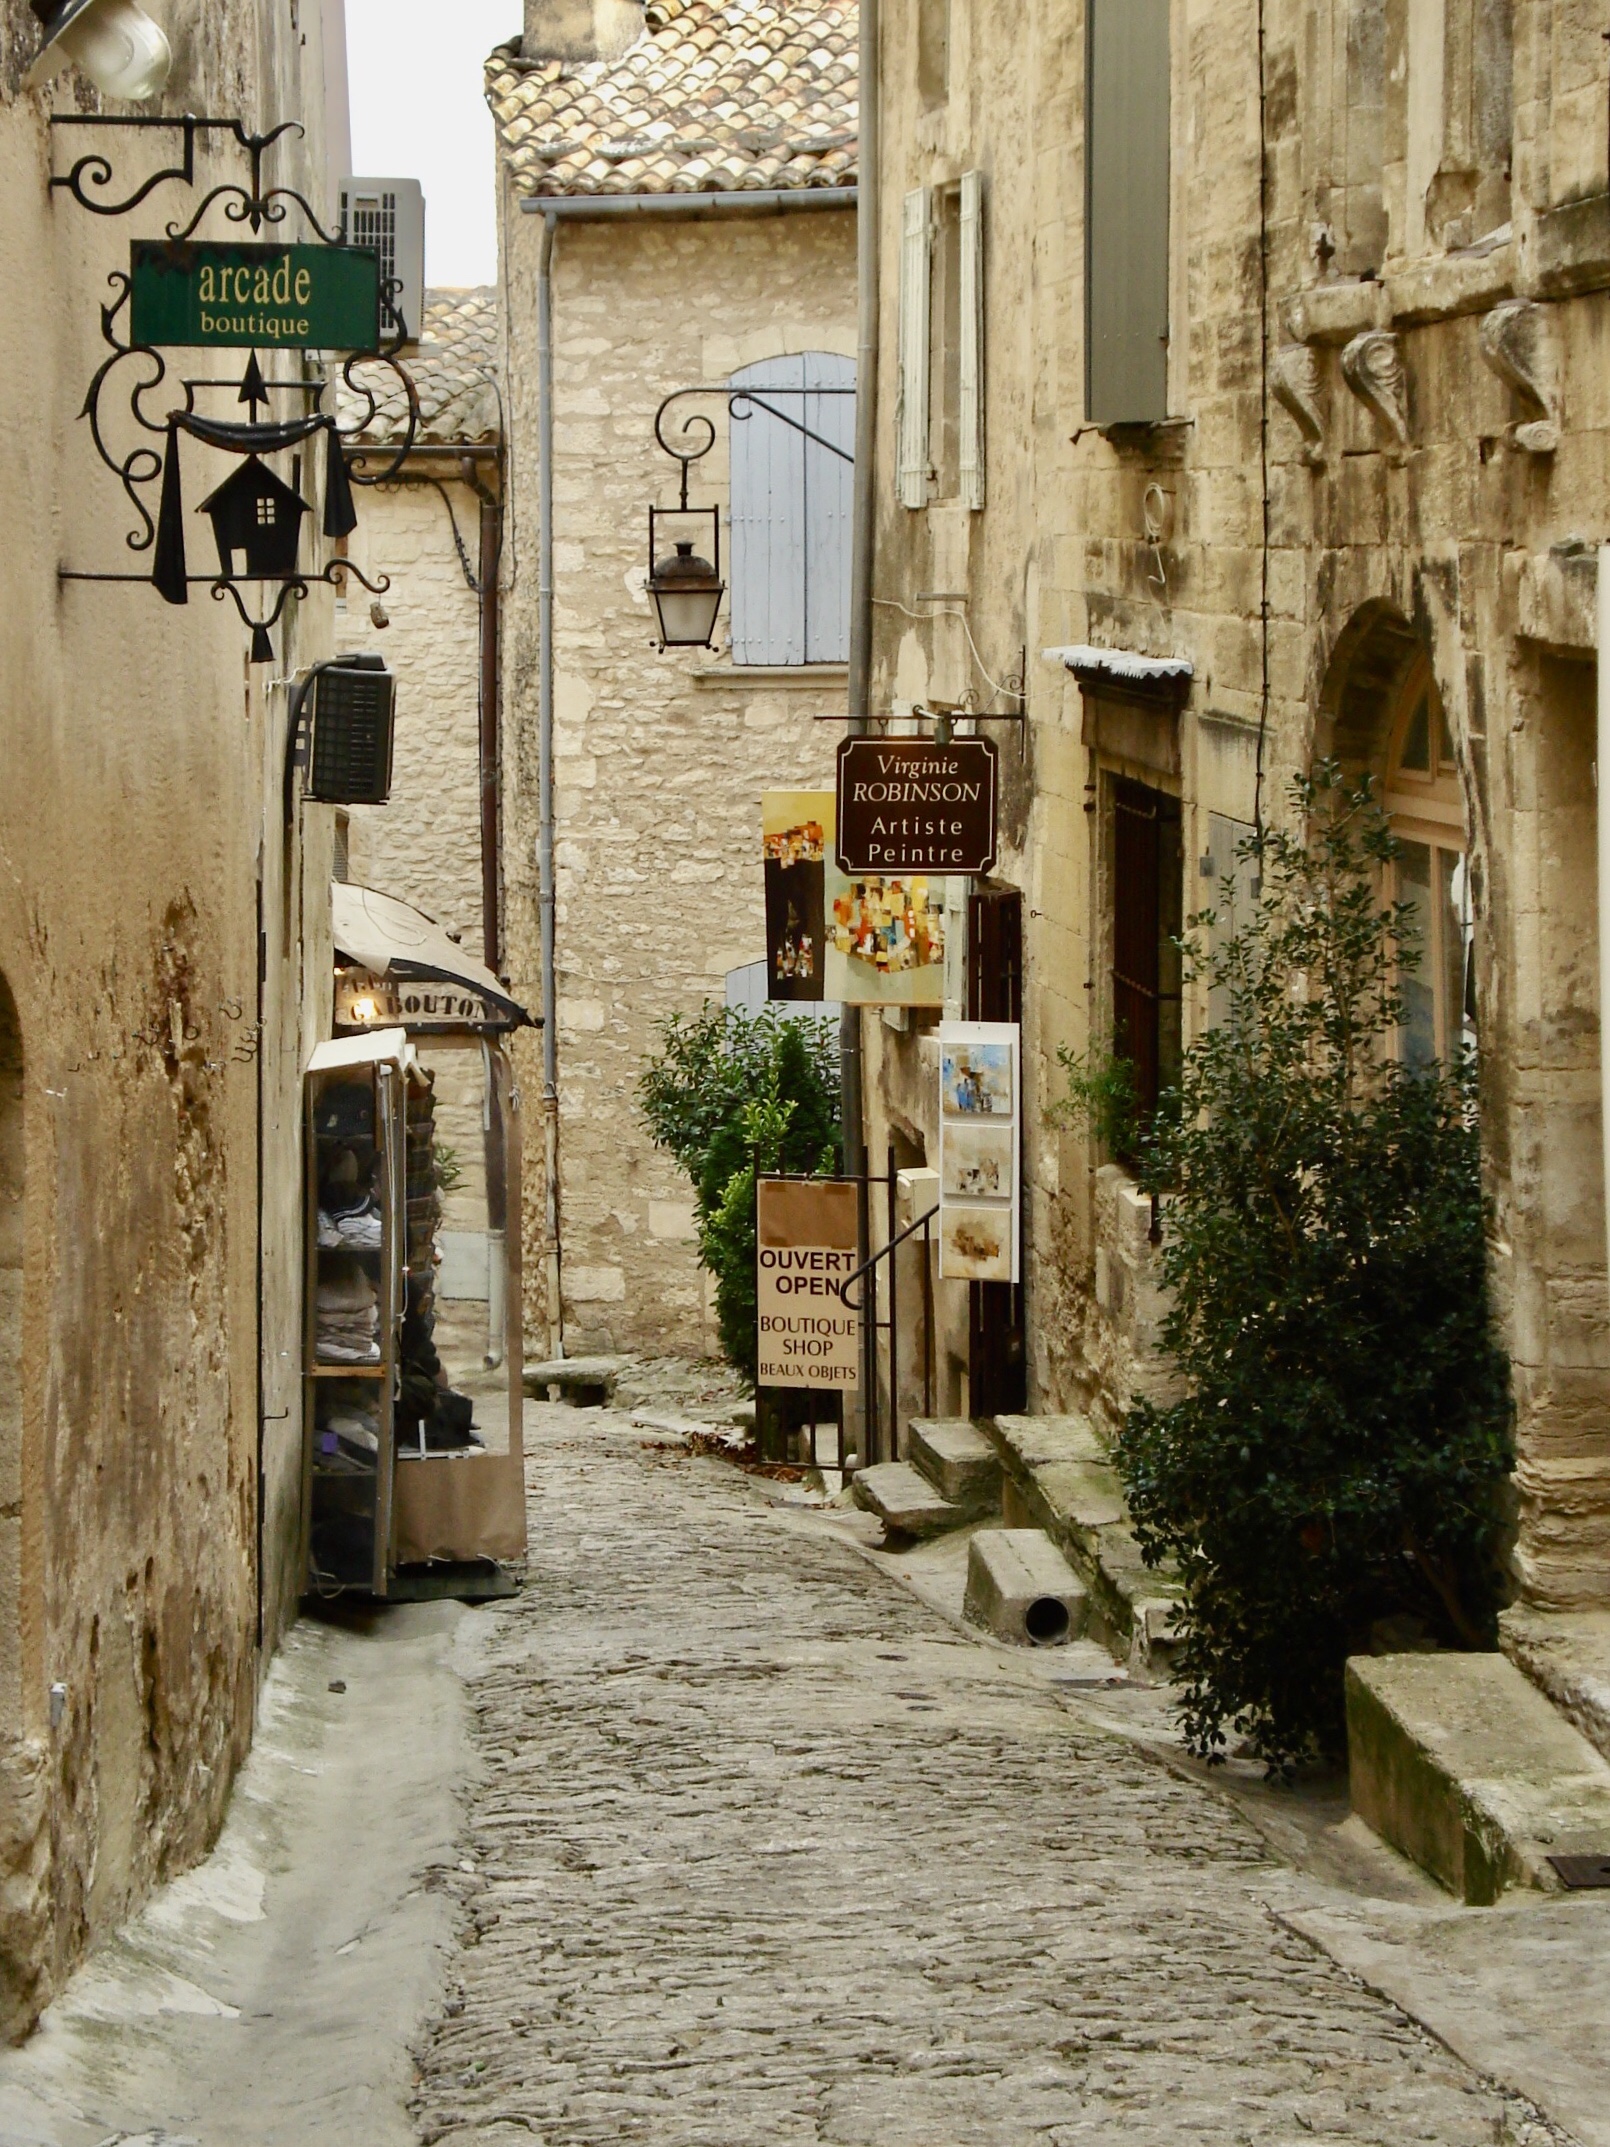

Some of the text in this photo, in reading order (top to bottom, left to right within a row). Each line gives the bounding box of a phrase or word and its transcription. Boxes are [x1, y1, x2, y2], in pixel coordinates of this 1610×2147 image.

[199, 254, 311, 305] arcade
[201, 311, 310, 339] boutique
[877, 755, 959, 779] Virginie
[853, 782, 981, 802] ROBINSON
[870, 816, 963, 835] Artiste
[868, 843, 964, 863] Peintre
[760, 1250, 856, 1272] OUVERT
[776, 1275, 840, 1297] OPEN
[760, 1316, 856, 1337] BOUTIQUE
[783, 1339, 834, 1356] SHOP
[760, 1363, 856, 1381] BEAUX OBJETS
